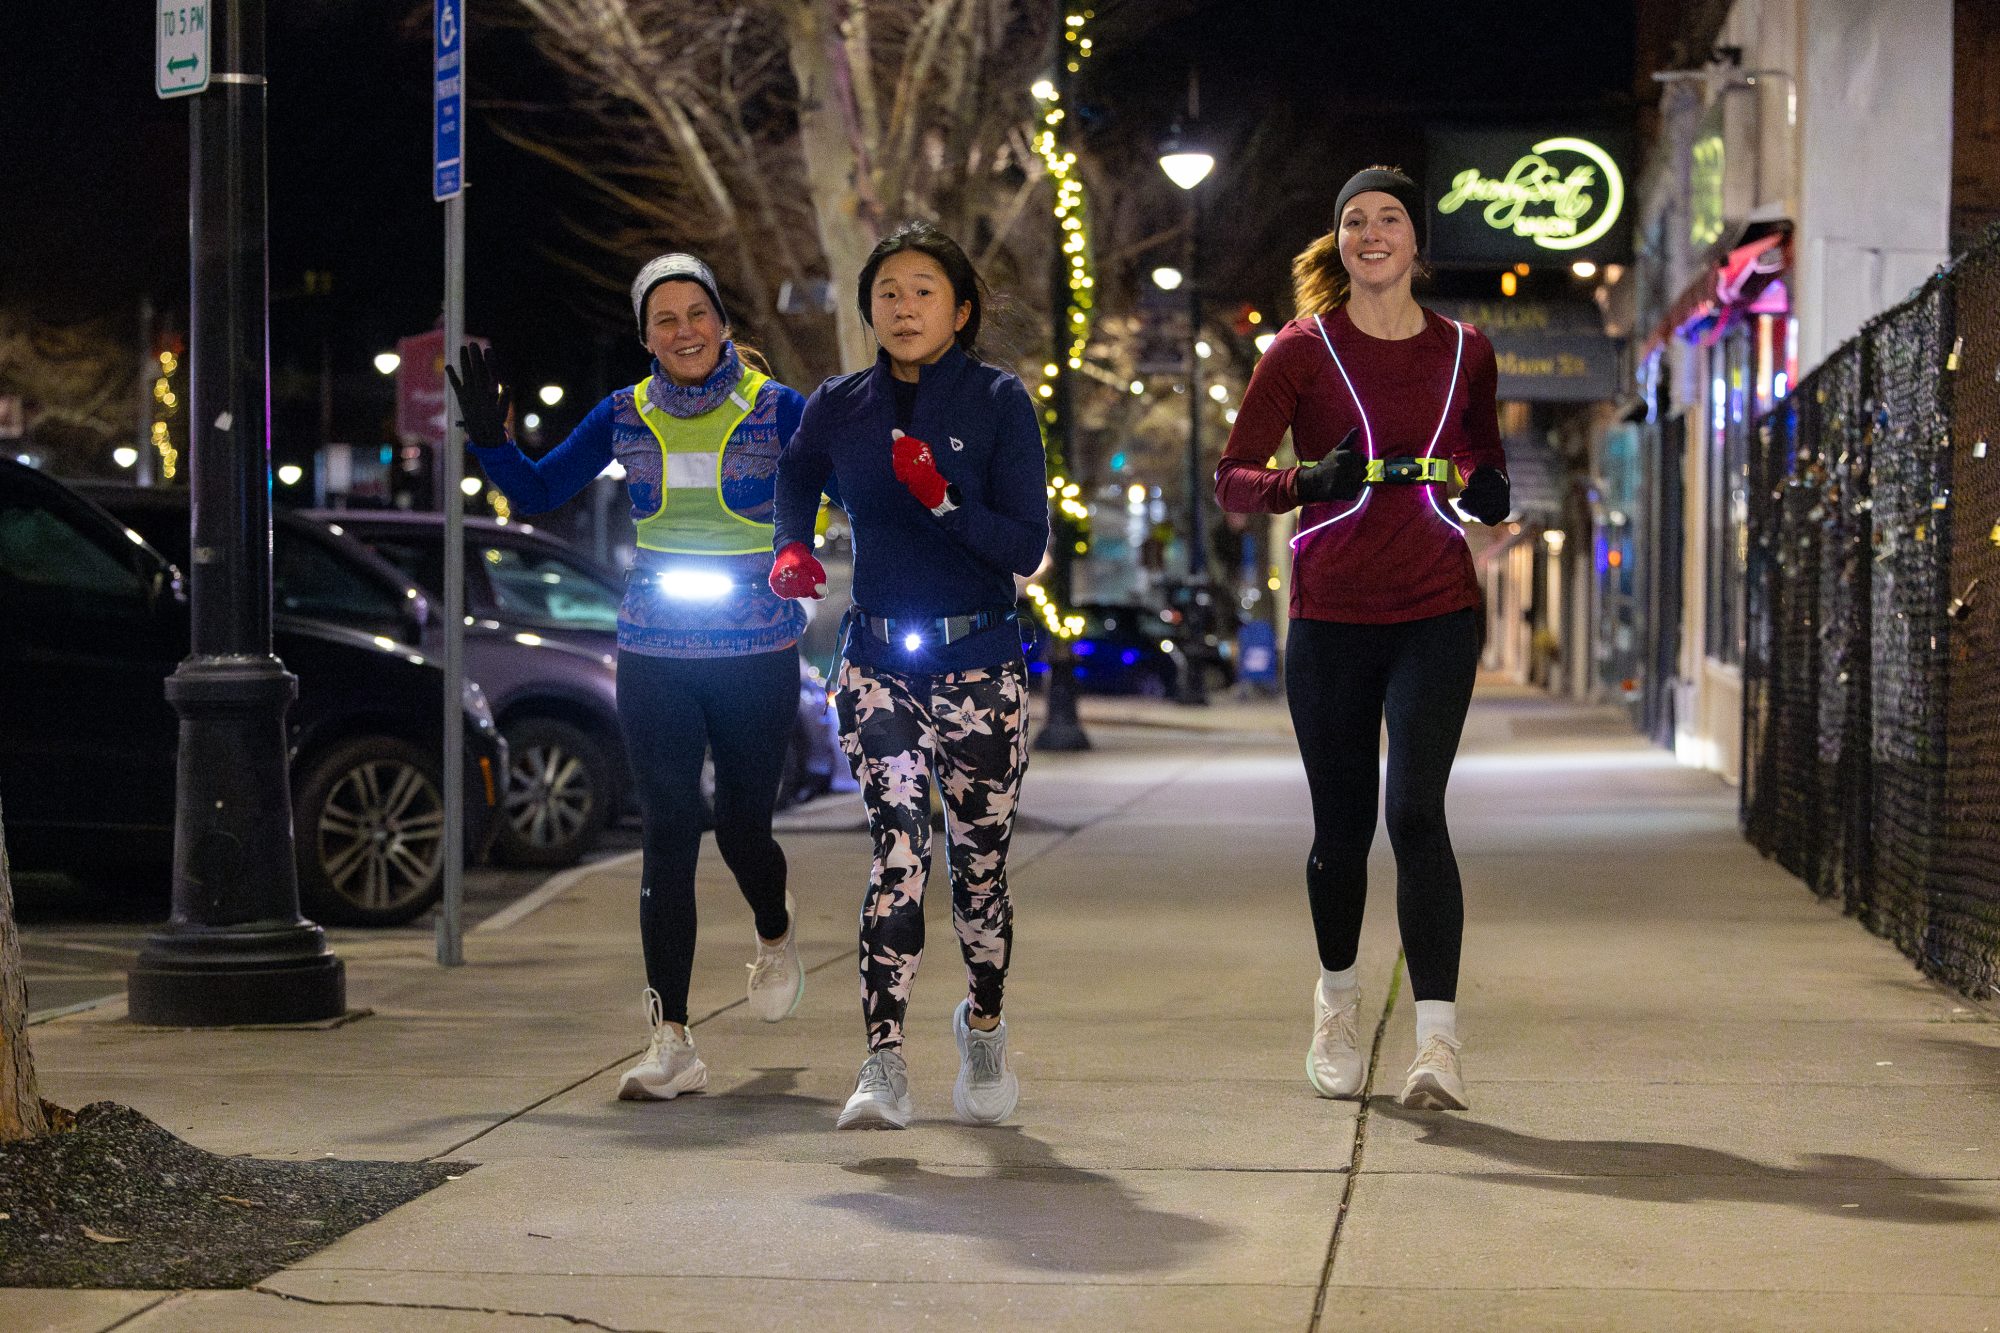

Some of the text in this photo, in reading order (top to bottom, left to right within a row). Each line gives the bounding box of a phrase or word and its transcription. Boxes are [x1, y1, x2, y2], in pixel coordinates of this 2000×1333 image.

[163, 6, 204, 37] TO 5 PM
